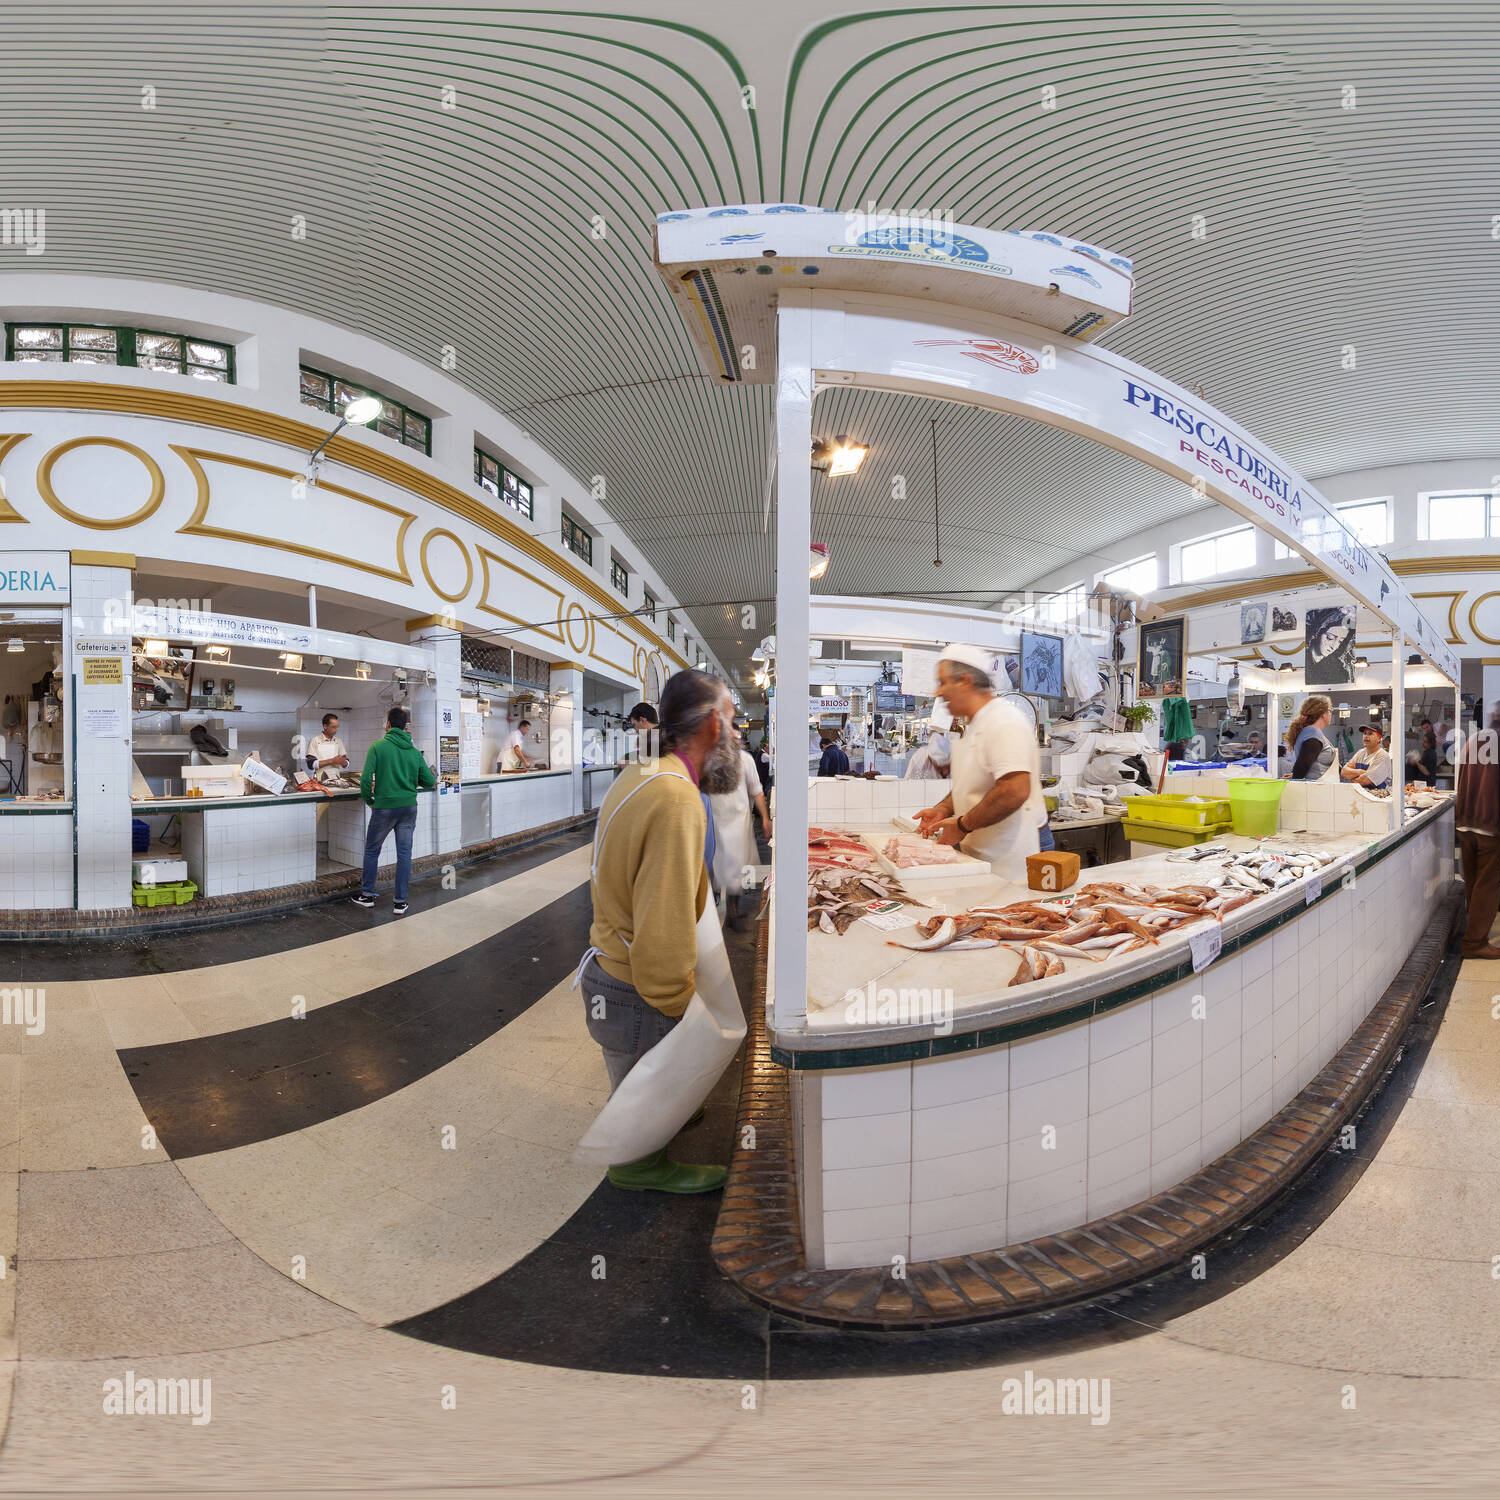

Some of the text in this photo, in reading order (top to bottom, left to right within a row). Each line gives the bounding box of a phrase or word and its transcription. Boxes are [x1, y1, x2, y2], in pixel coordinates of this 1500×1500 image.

[838, 246, 860, 254] Los
[931, 254, 946, 262] de
[951, 257, 1008, 273] Canarias
[1123, 380, 1302, 511] PESCADERIA
[1179, 439, 1285, 517] PESCADOS
[1292, 513, 1300, 527] Y
[240, 622, 279, 635] APARICIO
